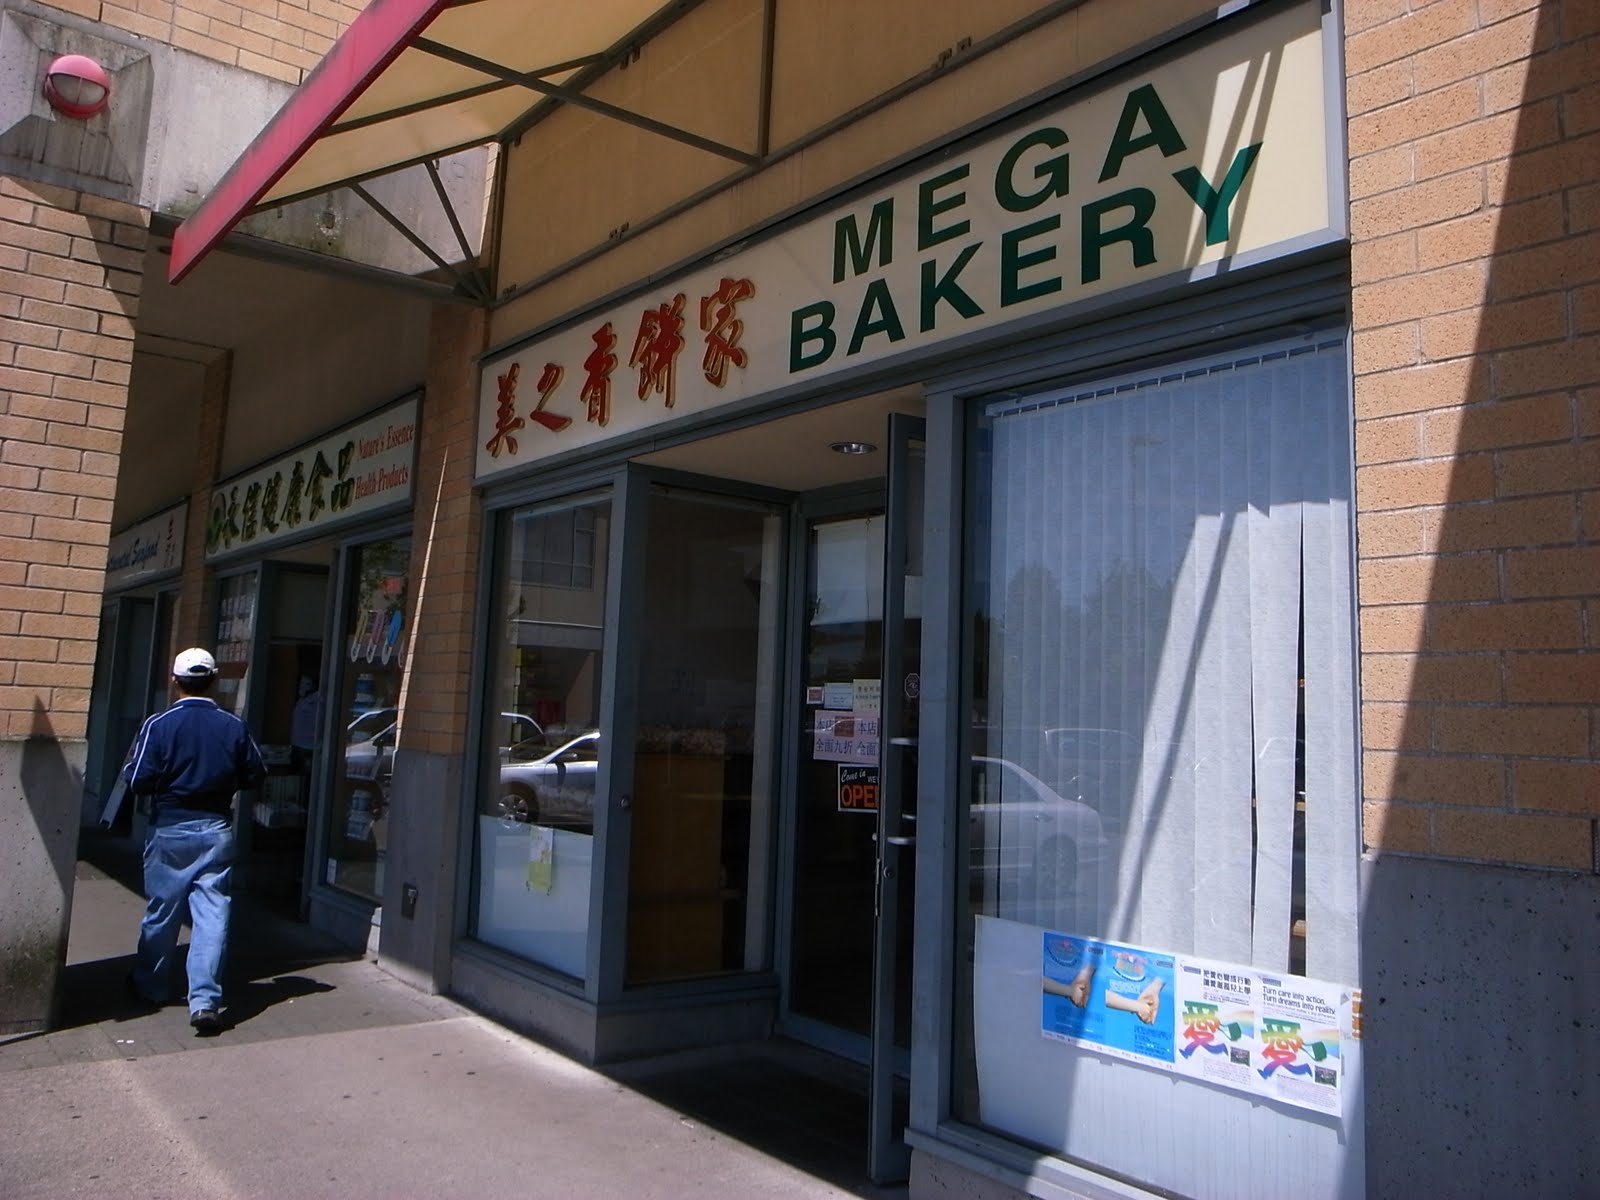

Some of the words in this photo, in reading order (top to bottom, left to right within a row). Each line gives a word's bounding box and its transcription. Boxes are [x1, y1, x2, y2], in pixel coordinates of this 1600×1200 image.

[833, 83, 1188, 285] MEGA
[789, 141, 1264, 375] BAKERY
[358, 433, 385, 461] Nature's
[386, 424, 414, 450] Essence
[355, 472, 378, 500] Health
[378, 463, 409, 492] Products
[816, 738, 853, 755] 全面九折
[857, 741, 880, 757] 全面
[841, 769, 858, 783] Come
[860, 768, 867, 778] in
[1263, 986, 1276, 995] Turn
[1278, 990, 1291, 998] care
[1293, 992, 1304, 1000] into
[1263, 994, 1276, 1002] Turn
[1278, 997, 1300, 1007] dreams
[1302, 1002, 1314, 1010] into
